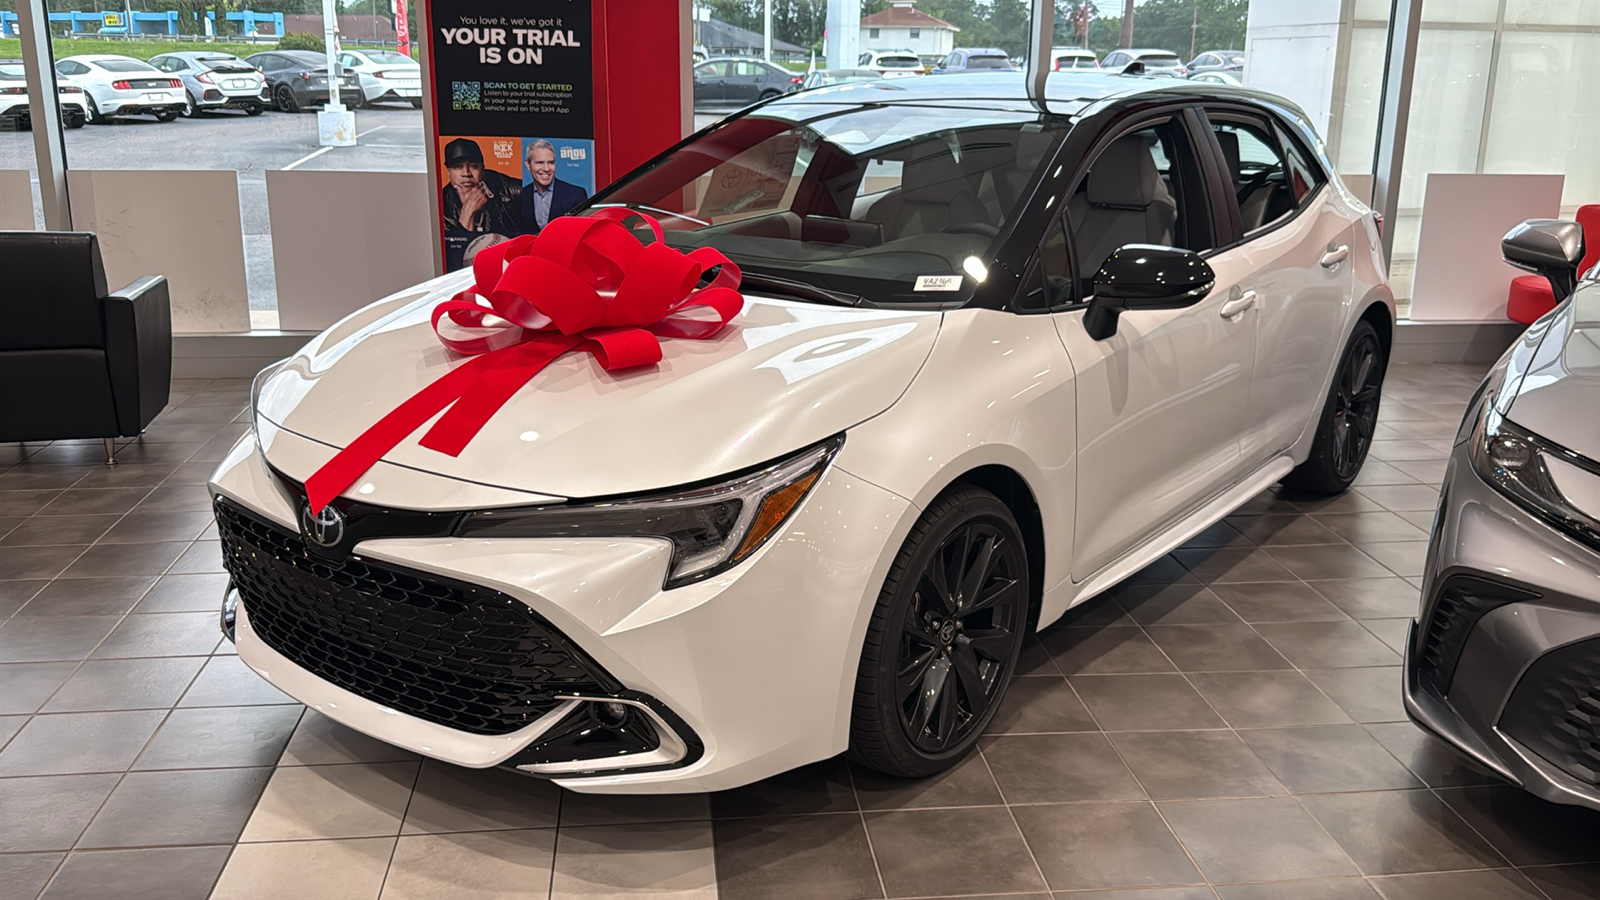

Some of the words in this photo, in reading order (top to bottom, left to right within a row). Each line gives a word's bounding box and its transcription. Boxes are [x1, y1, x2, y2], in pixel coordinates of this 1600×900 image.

[459, 16, 477, 25] You
[480, 16, 498, 25] love
[500, 17, 508, 26] it,
[510, 17, 536, 26] we've
[538, 18, 554, 27] got
[556, 18, 563, 26] it
[441, 28, 506, 45] YOUR
[512, 29, 581, 47] TRIAL
[479, 47, 501, 64] IS
[507, 48, 542, 65] ON
[536, 83, 573, 91] STARTED
[556, 106, 570, 114] App
[493, 143, 513, 152] ROCK
[560, 148, 586, 160] andy
